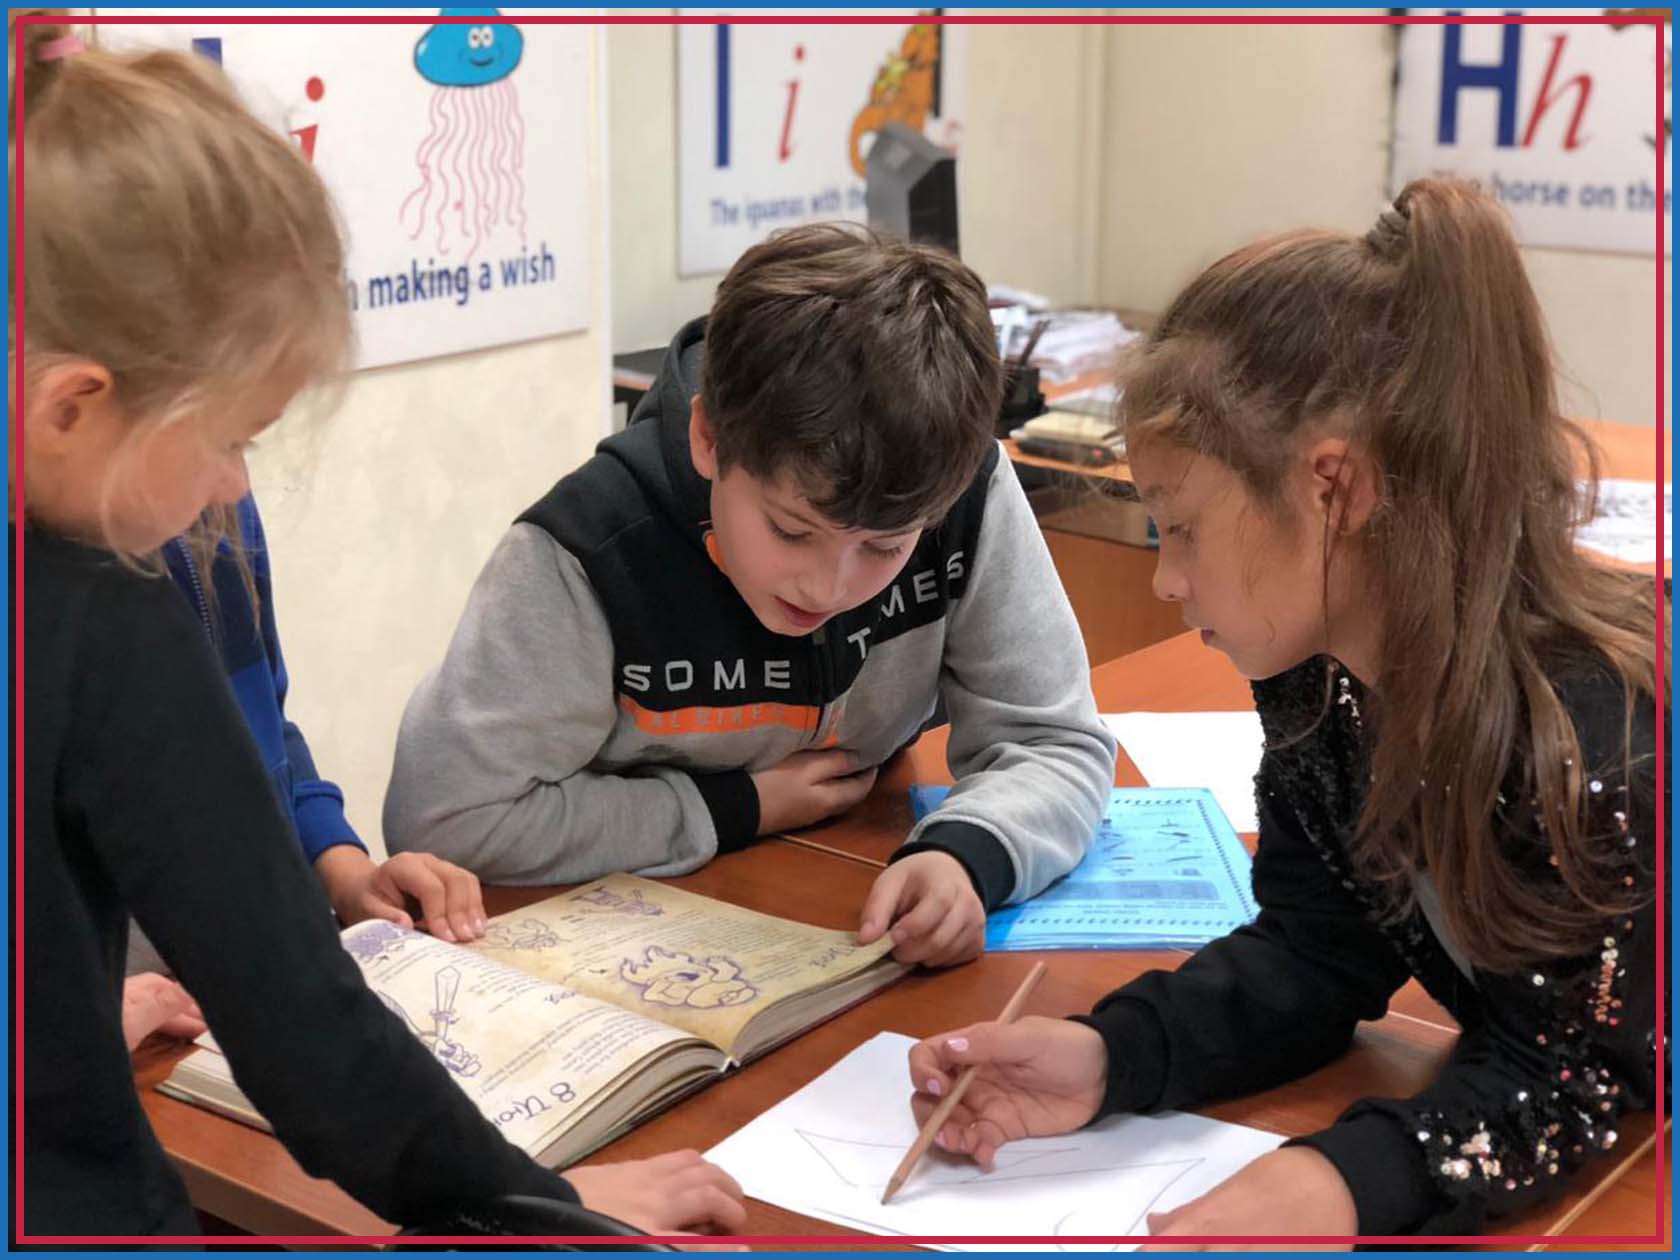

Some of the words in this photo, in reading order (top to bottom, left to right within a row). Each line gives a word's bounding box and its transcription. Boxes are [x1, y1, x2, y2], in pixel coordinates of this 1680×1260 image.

[1491, 172, 1568, 206] horse
[1579, 184, 1616, 208] on
[368, 258, 470, 309] making
[479, 261, 492, 291] a
[500, 241, 556, 288] wish
[623, 658, 791, 692] SOME
[549, 1081, 577, 1103] 8
